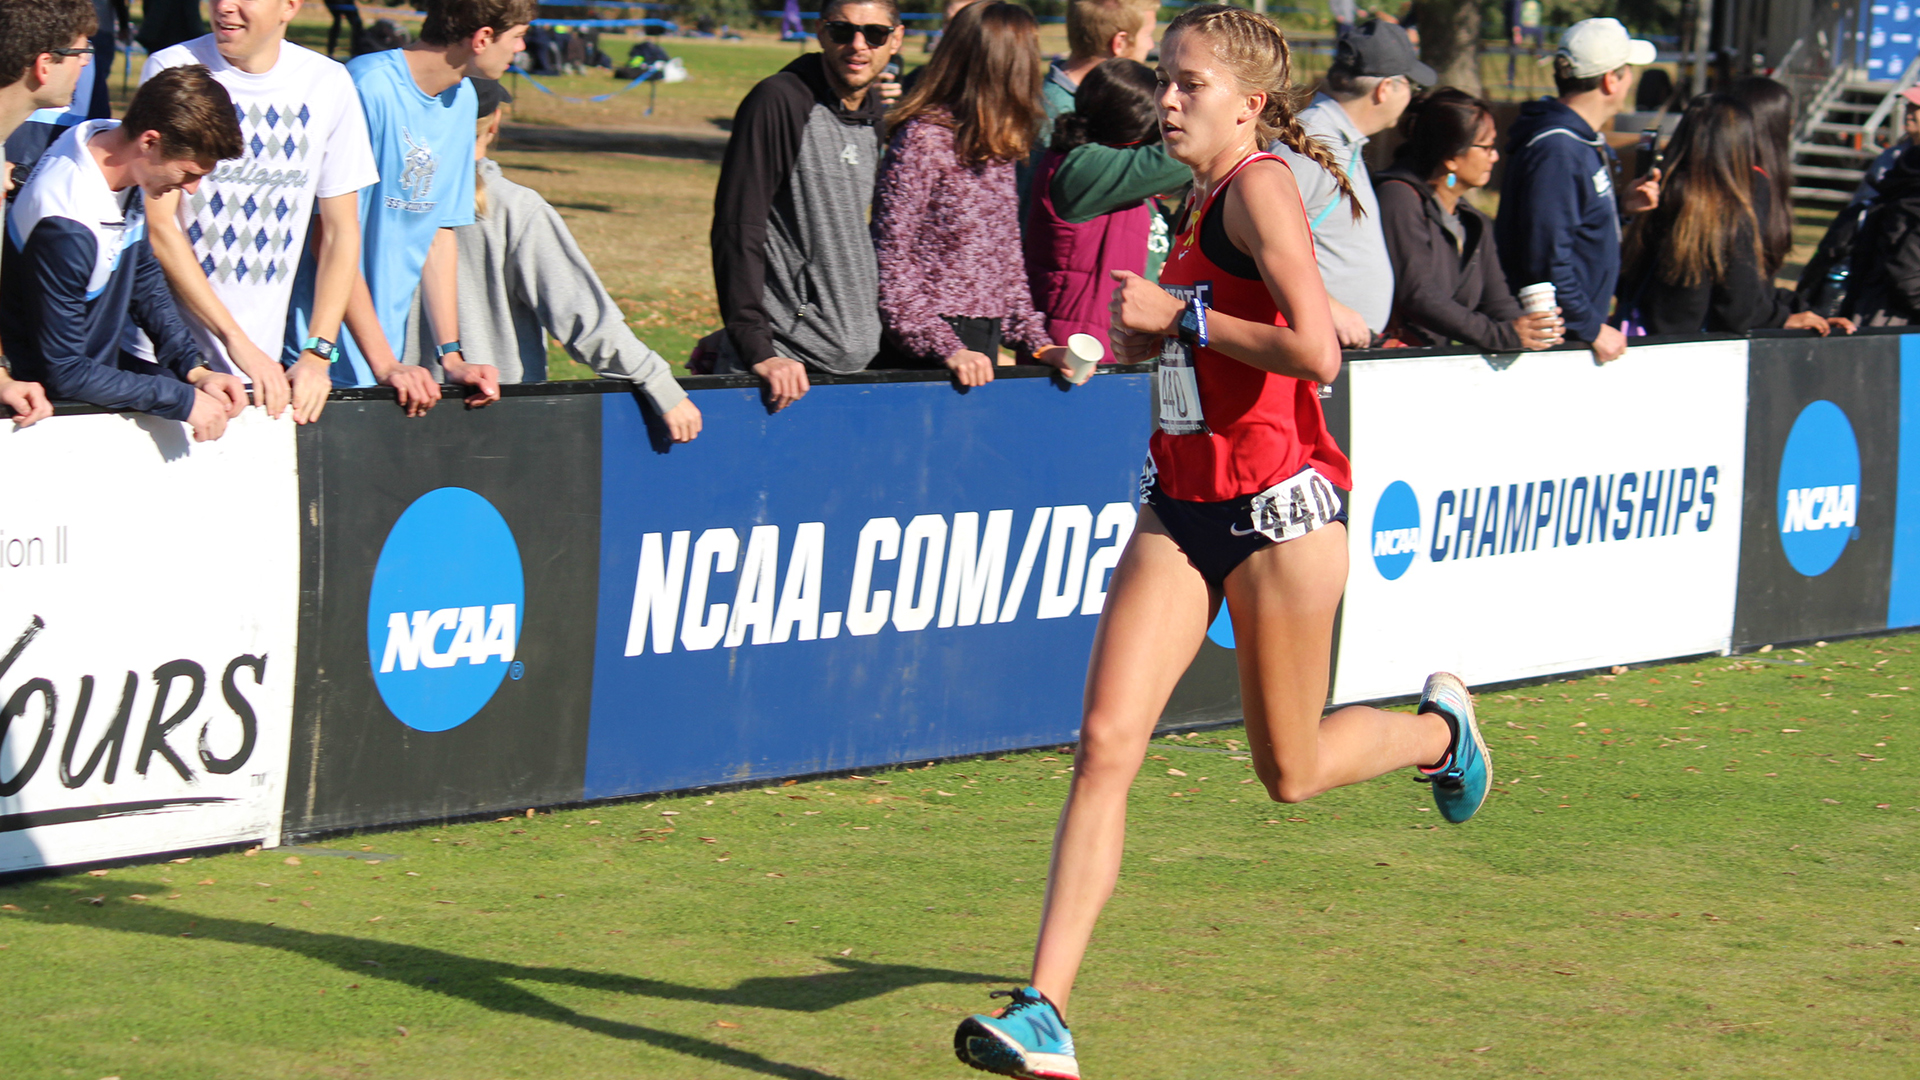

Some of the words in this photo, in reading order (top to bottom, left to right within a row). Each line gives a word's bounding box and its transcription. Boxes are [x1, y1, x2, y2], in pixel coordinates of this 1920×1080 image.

[1162, 369, 1188, 418] 440
[1260, 474, 1336, 539] 440
[1373, 527, 1420, 557] NCAA
[1430, 465, 1718, 562] CHAMPIONSHIPS
[1781, 484, 1857, 533] NCAA
[624, 501, 1138, 657] NCAA.COM/D2
[379, 603, 516, 673] NCAA
